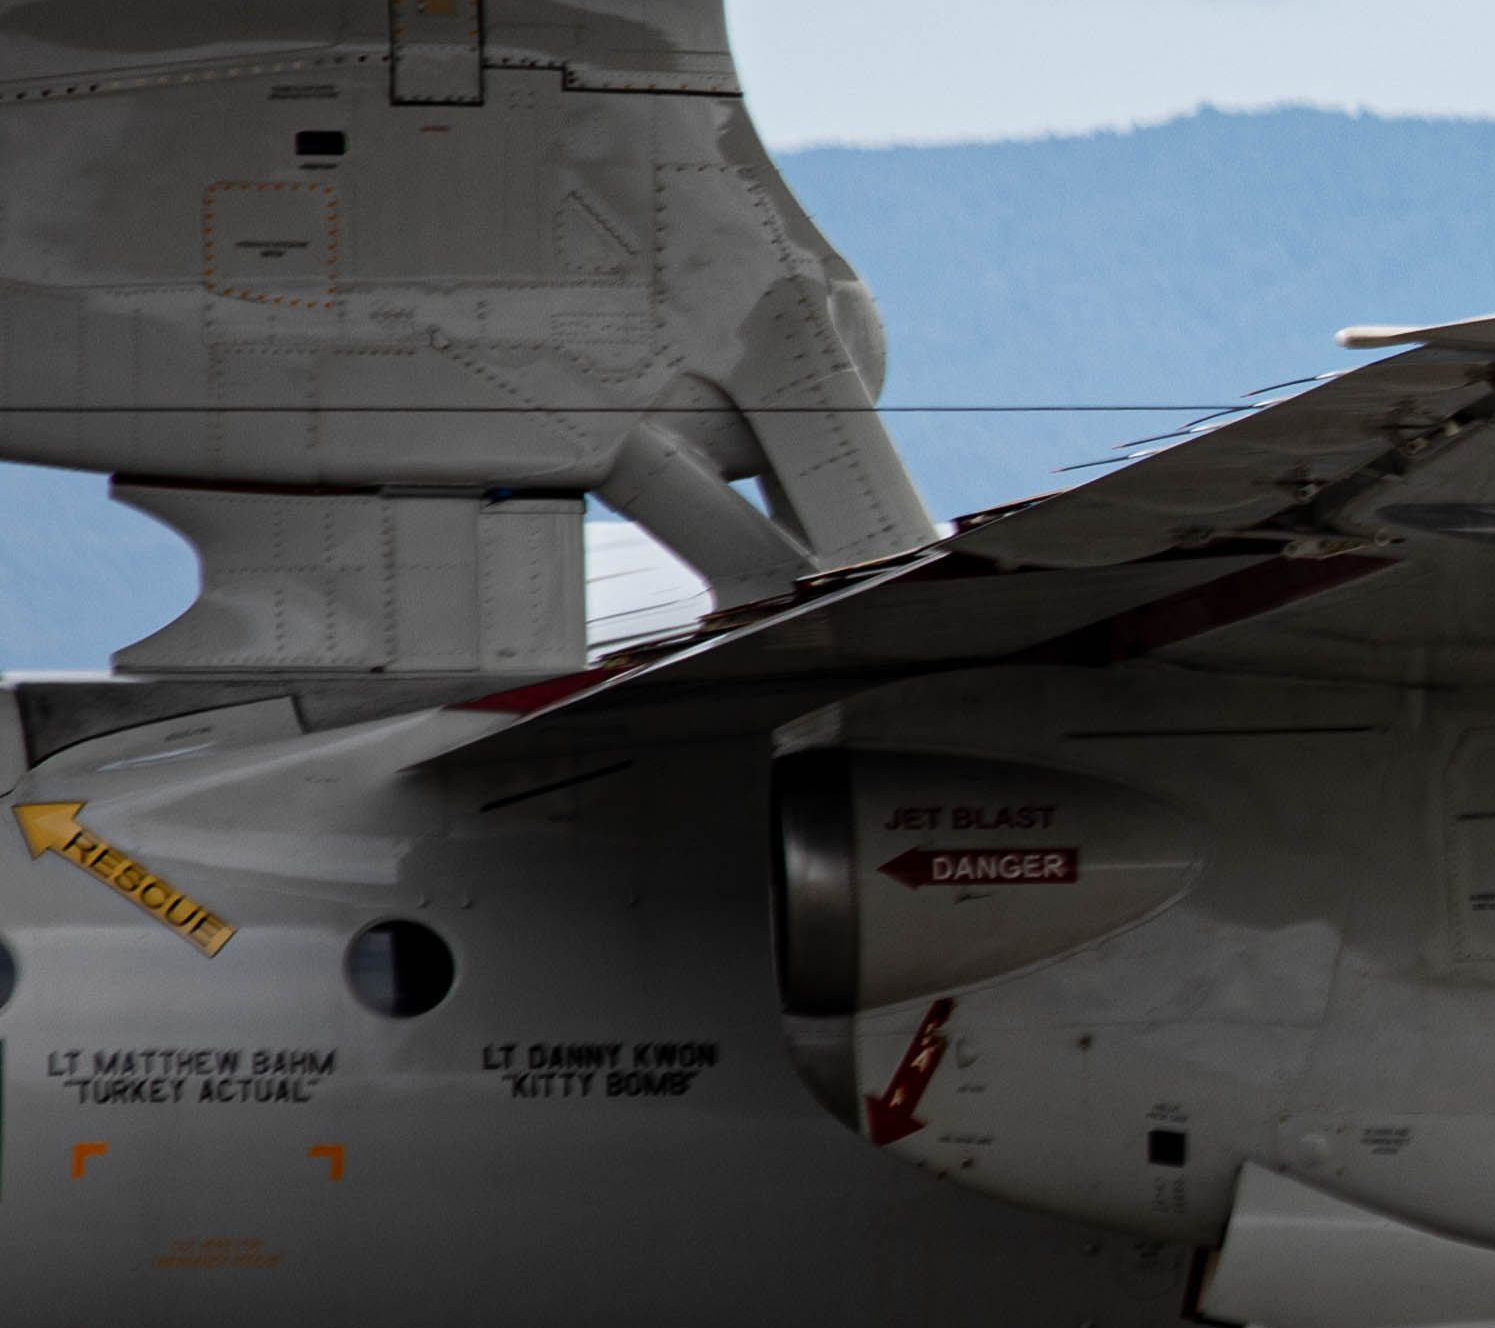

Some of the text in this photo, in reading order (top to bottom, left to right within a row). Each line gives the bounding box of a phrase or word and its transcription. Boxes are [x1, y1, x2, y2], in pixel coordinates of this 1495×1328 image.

[884, 804, 1057, 831] JET BLAST
[932, 854, 1066, 880] DANGER
[62, 831, 226, 948] RESCUE
[47, 1048, 337, 1077] LT MATTHEW BAHM
[482, 1041, 719, 1070] LT DANNY KWON
